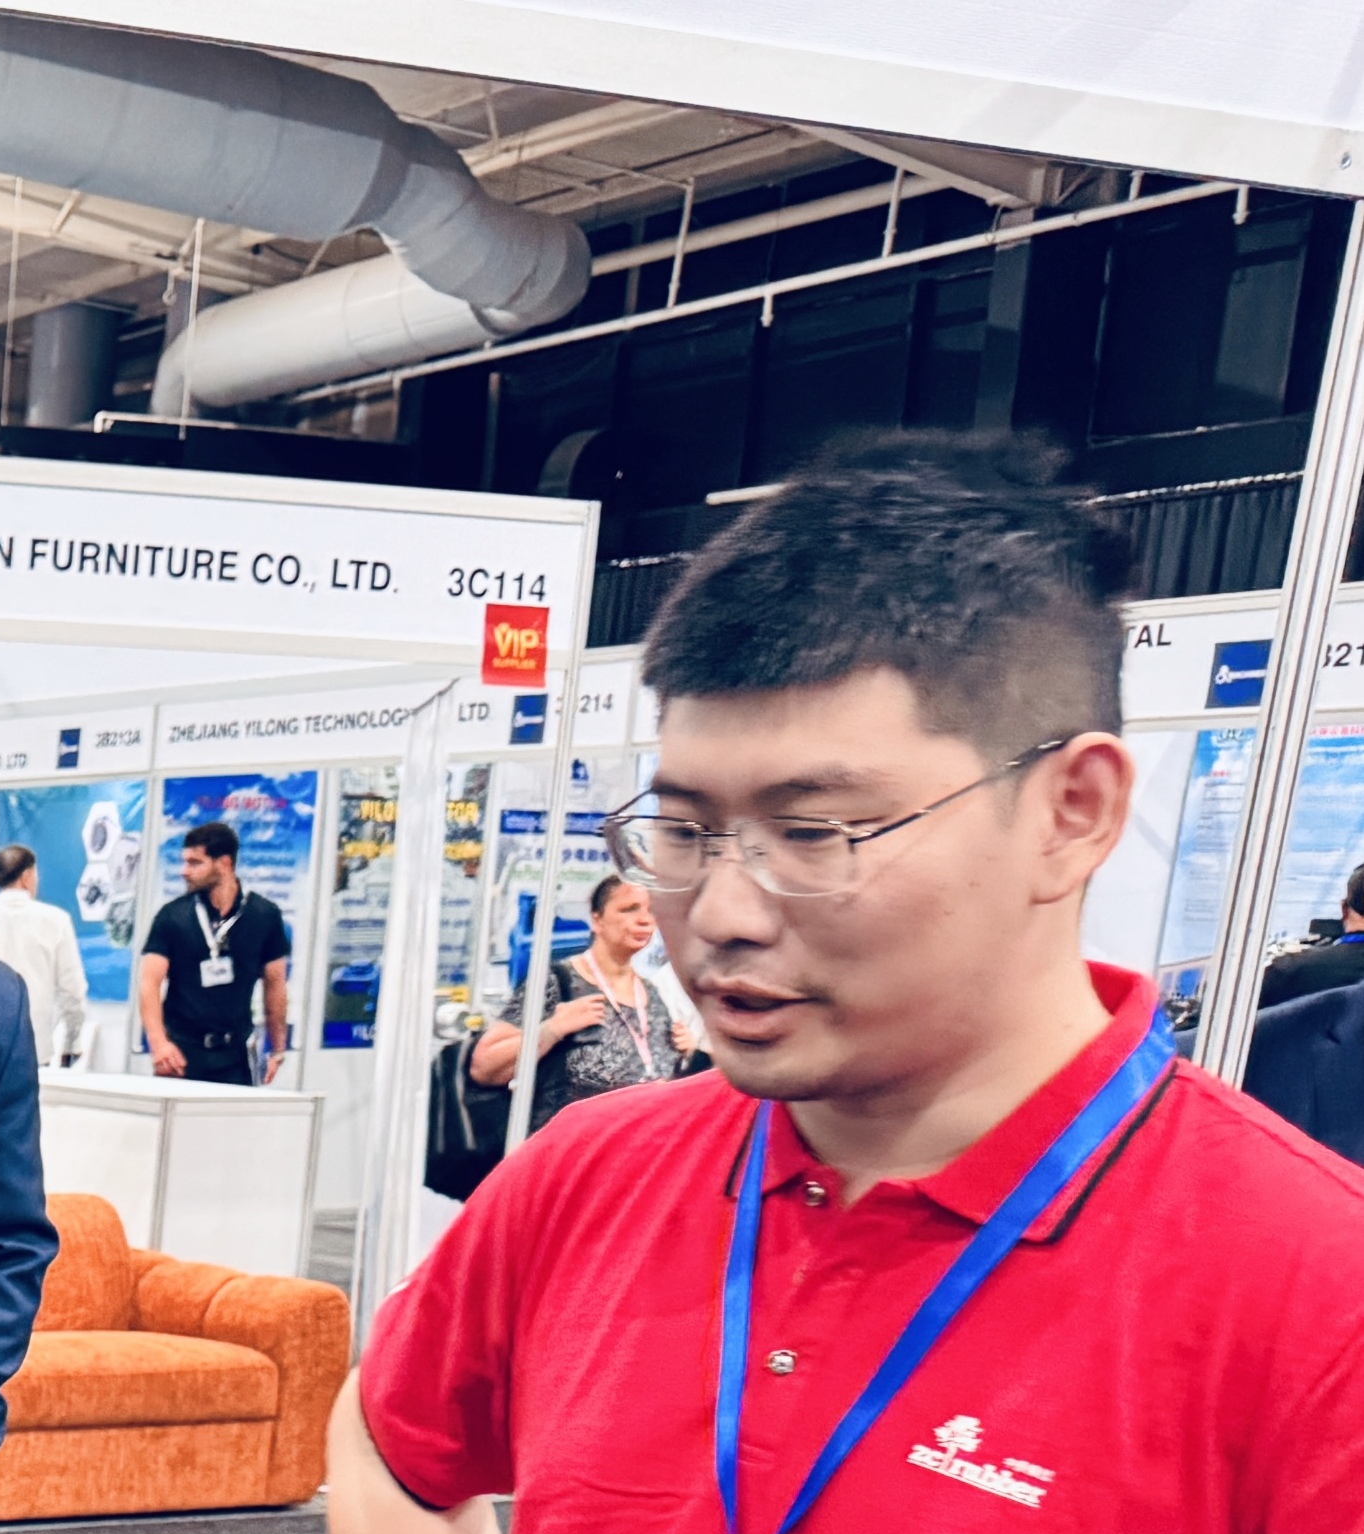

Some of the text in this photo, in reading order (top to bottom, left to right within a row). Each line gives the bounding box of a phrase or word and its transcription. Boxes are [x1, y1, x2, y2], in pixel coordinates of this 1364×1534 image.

[28, 538, 239, 582] FURNITURE
[251, 552, 317, 593] CO.,
[329, 558, 400, 594] LTD.
[447, 568, 546, 602] 3C114
[493, 624, 541, 659] VIP
[168, 720, 239, 743] ZHEJIANG
[245, 716, 299, 739] YILONG
